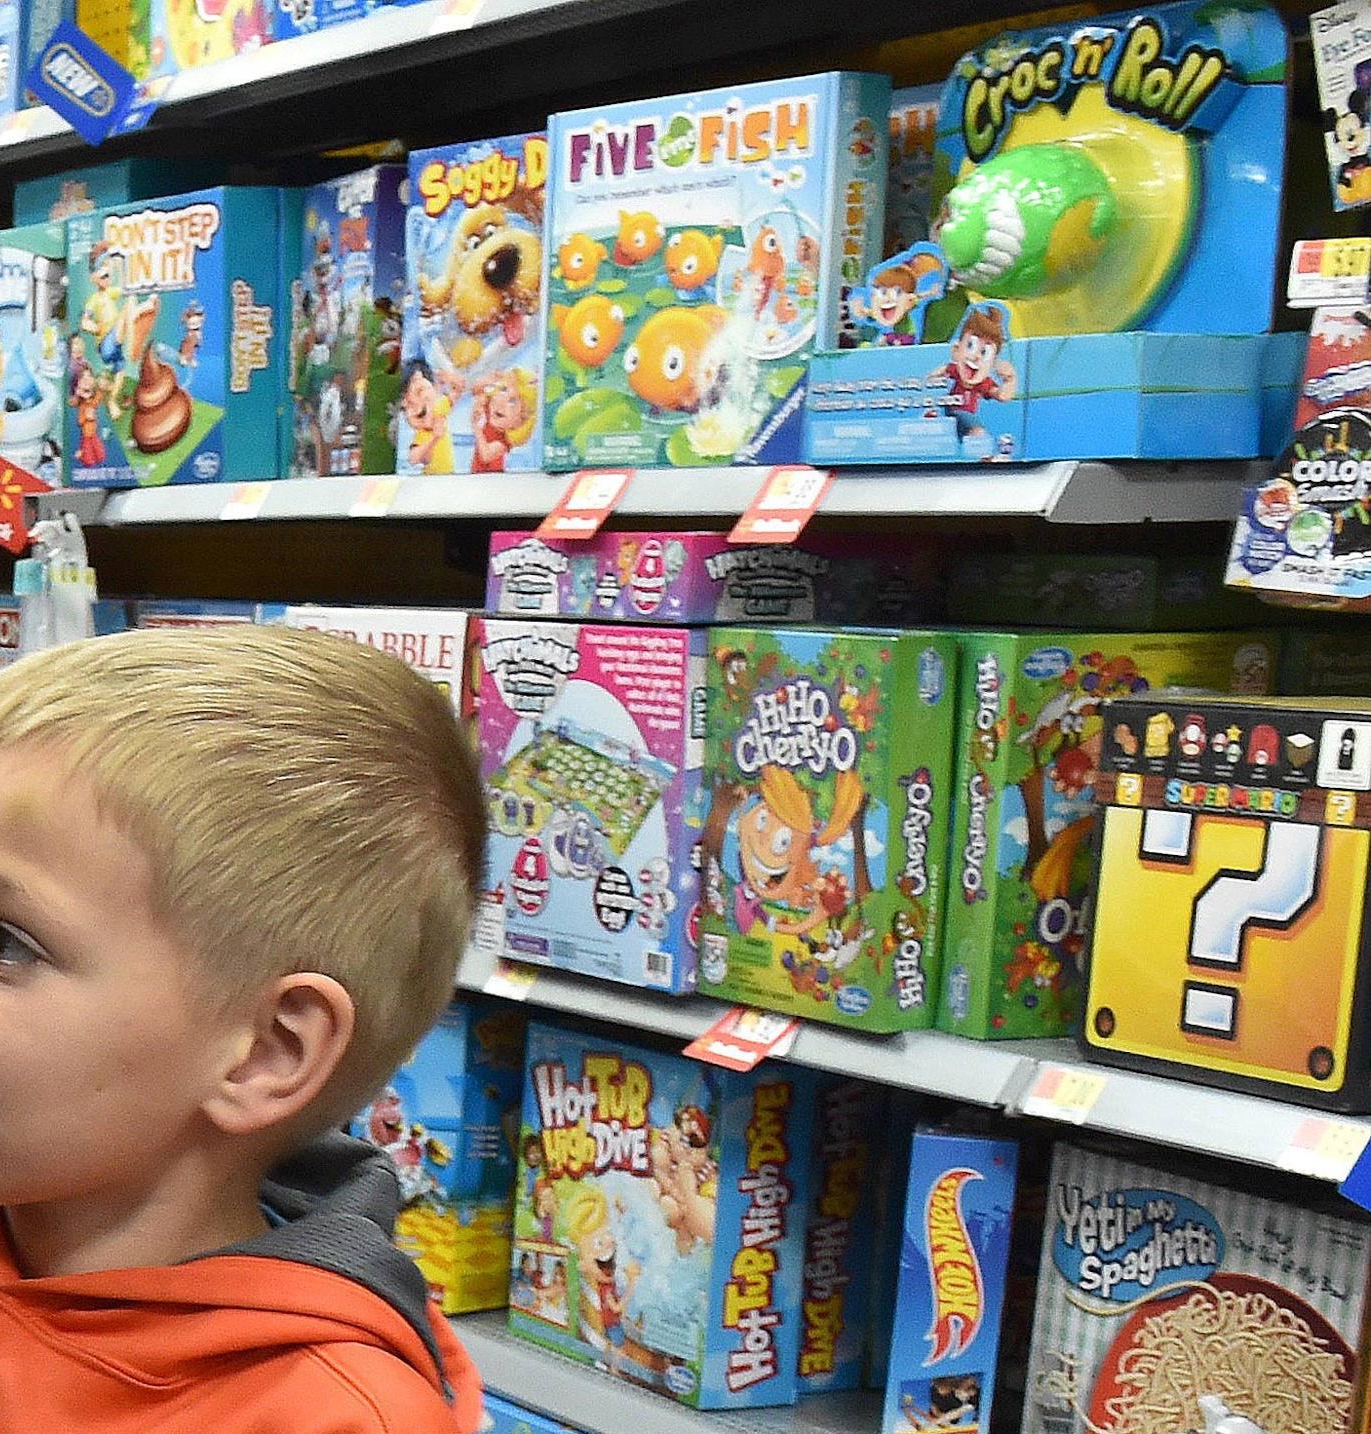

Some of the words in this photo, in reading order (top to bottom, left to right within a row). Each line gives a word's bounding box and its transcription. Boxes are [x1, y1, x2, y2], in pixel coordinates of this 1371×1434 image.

[963, 42, 1060, 160] Croc
[1113, 19, 1223, 128] Roll
[698, 103, 808, 164] FISH
[1058, 1184, 1124, 1252] Yeti
[1078, 1220, 1217, 1298] Spaghetti
